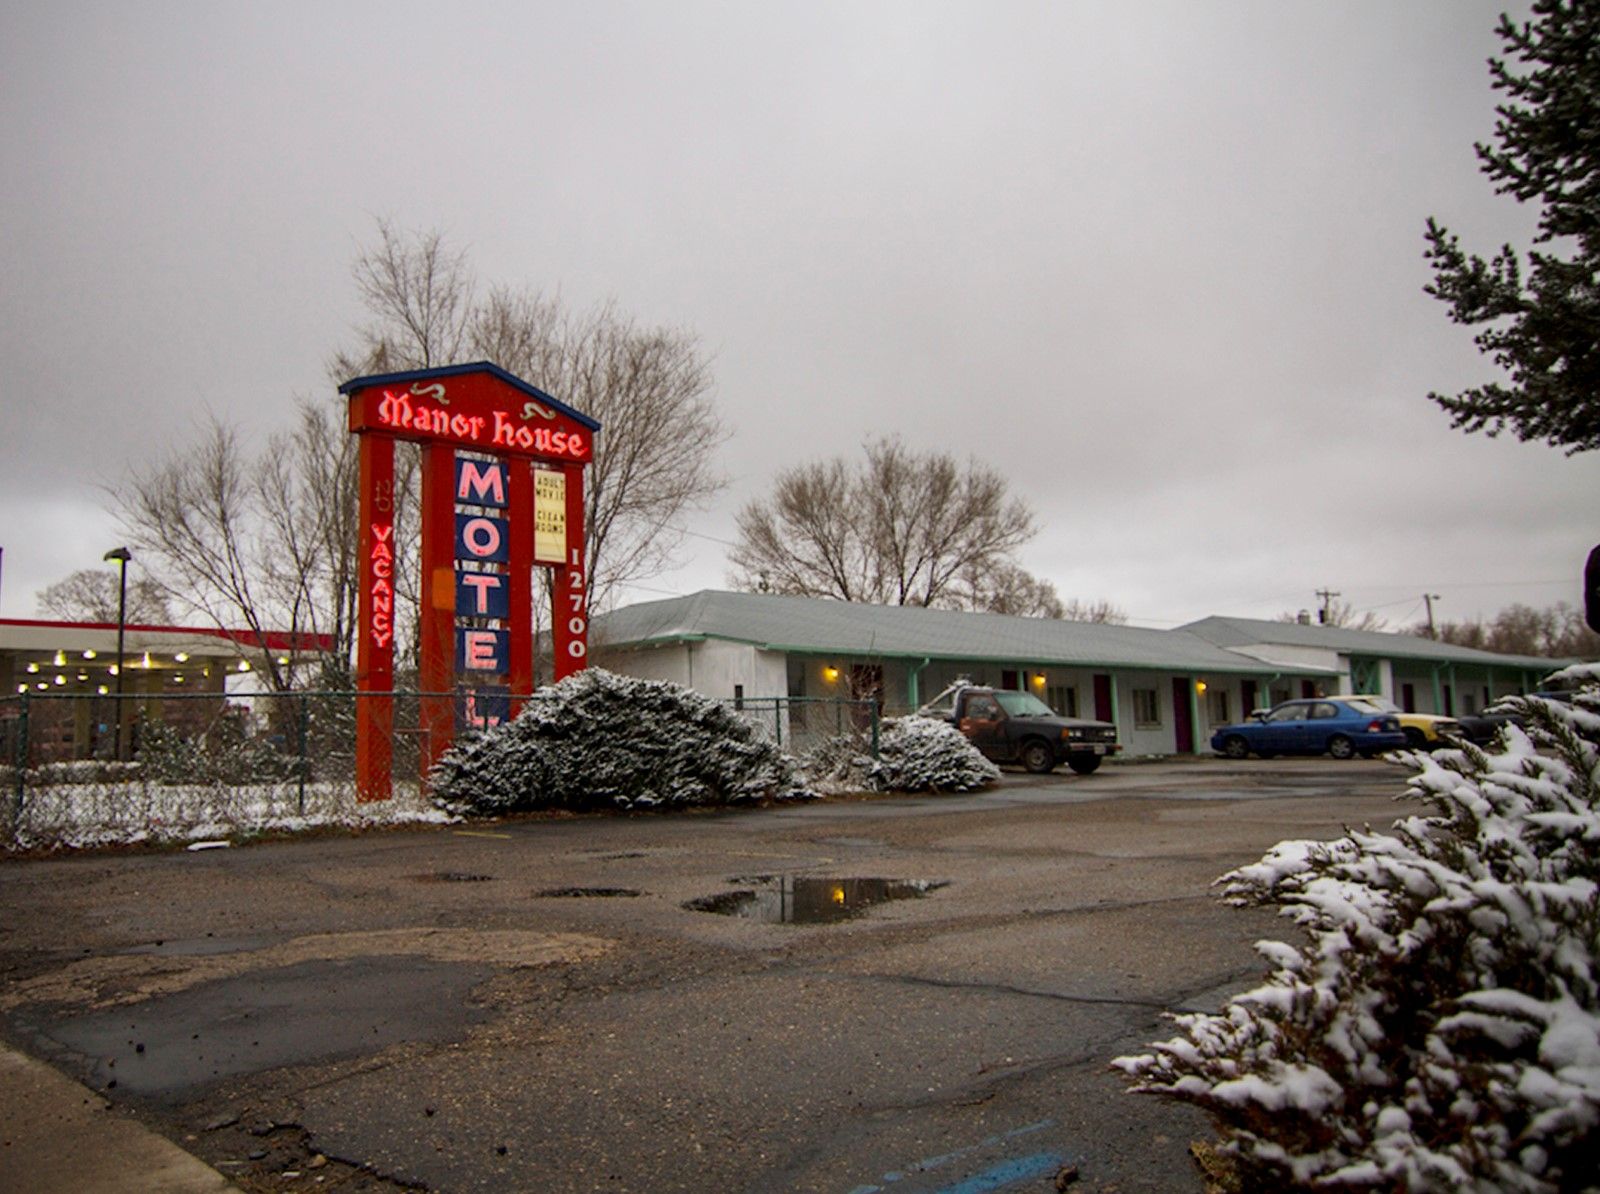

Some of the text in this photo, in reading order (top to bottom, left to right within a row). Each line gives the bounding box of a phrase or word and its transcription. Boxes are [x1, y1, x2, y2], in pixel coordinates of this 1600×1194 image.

[379, 391, 588, 457] Manor house
[537, 476, 564, 488] ADULT
[537, 510, 564, 522] CLEAN
[371, 524, 392, 648] VACANCY
[458, 461, 505, 726] MOTEL
[568, 548, 586, 658] 12700
